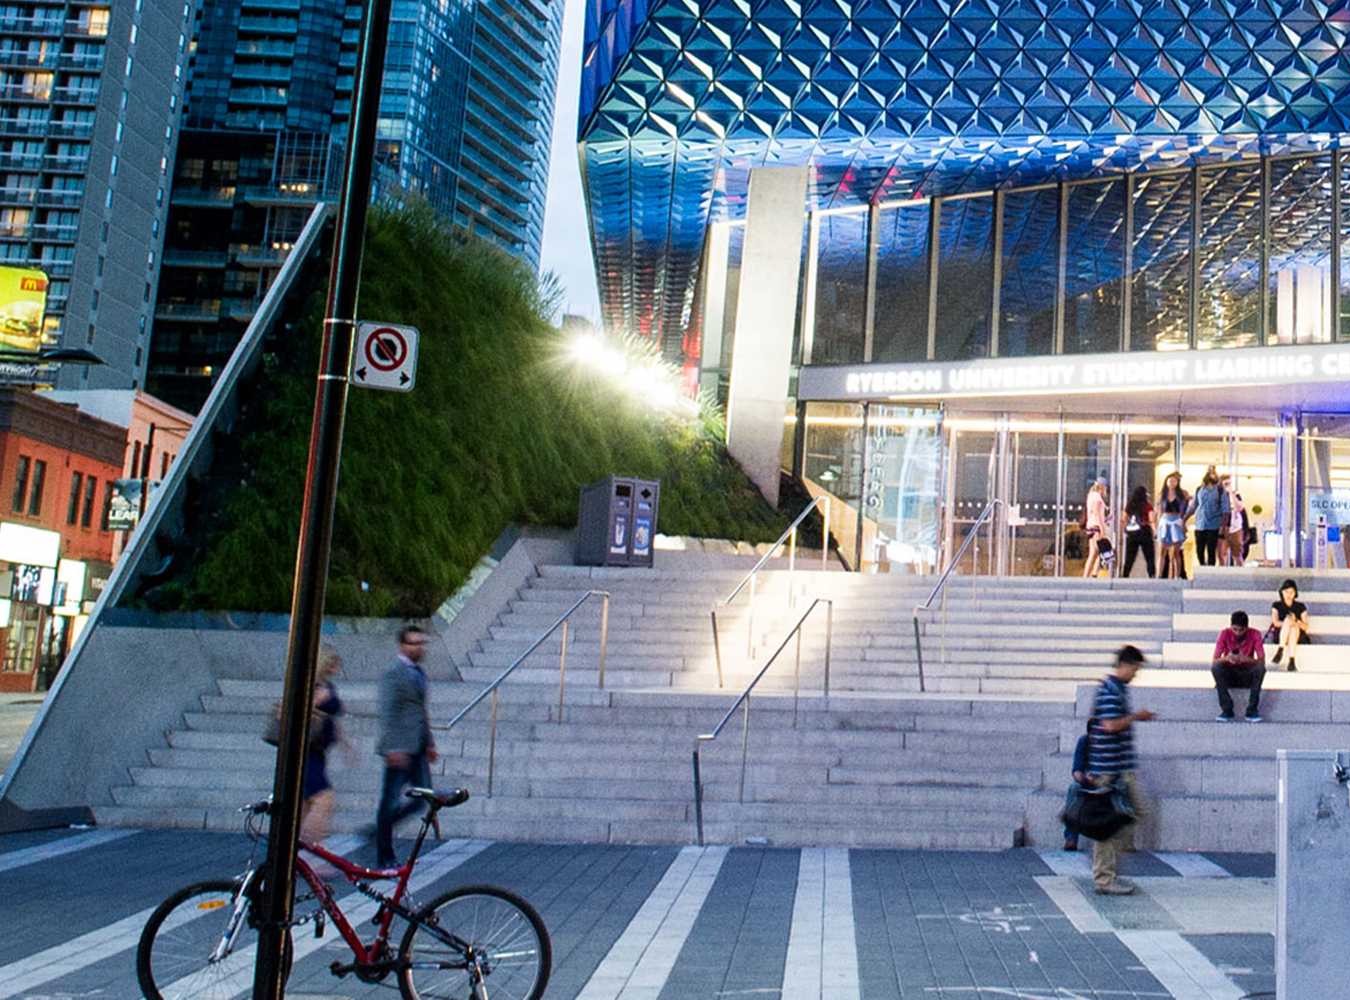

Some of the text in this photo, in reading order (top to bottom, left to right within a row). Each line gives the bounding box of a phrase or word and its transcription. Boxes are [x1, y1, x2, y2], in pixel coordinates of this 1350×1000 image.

[846, 370, 942, 393] RYERSON
[949, 365, 1075, 390] UNIVERSITY
[1082, 360, 1186, 385] STUDENT
[1195, 354, 1313, 379] LEARNING
[1311, 500, 1329, 509] SLC
